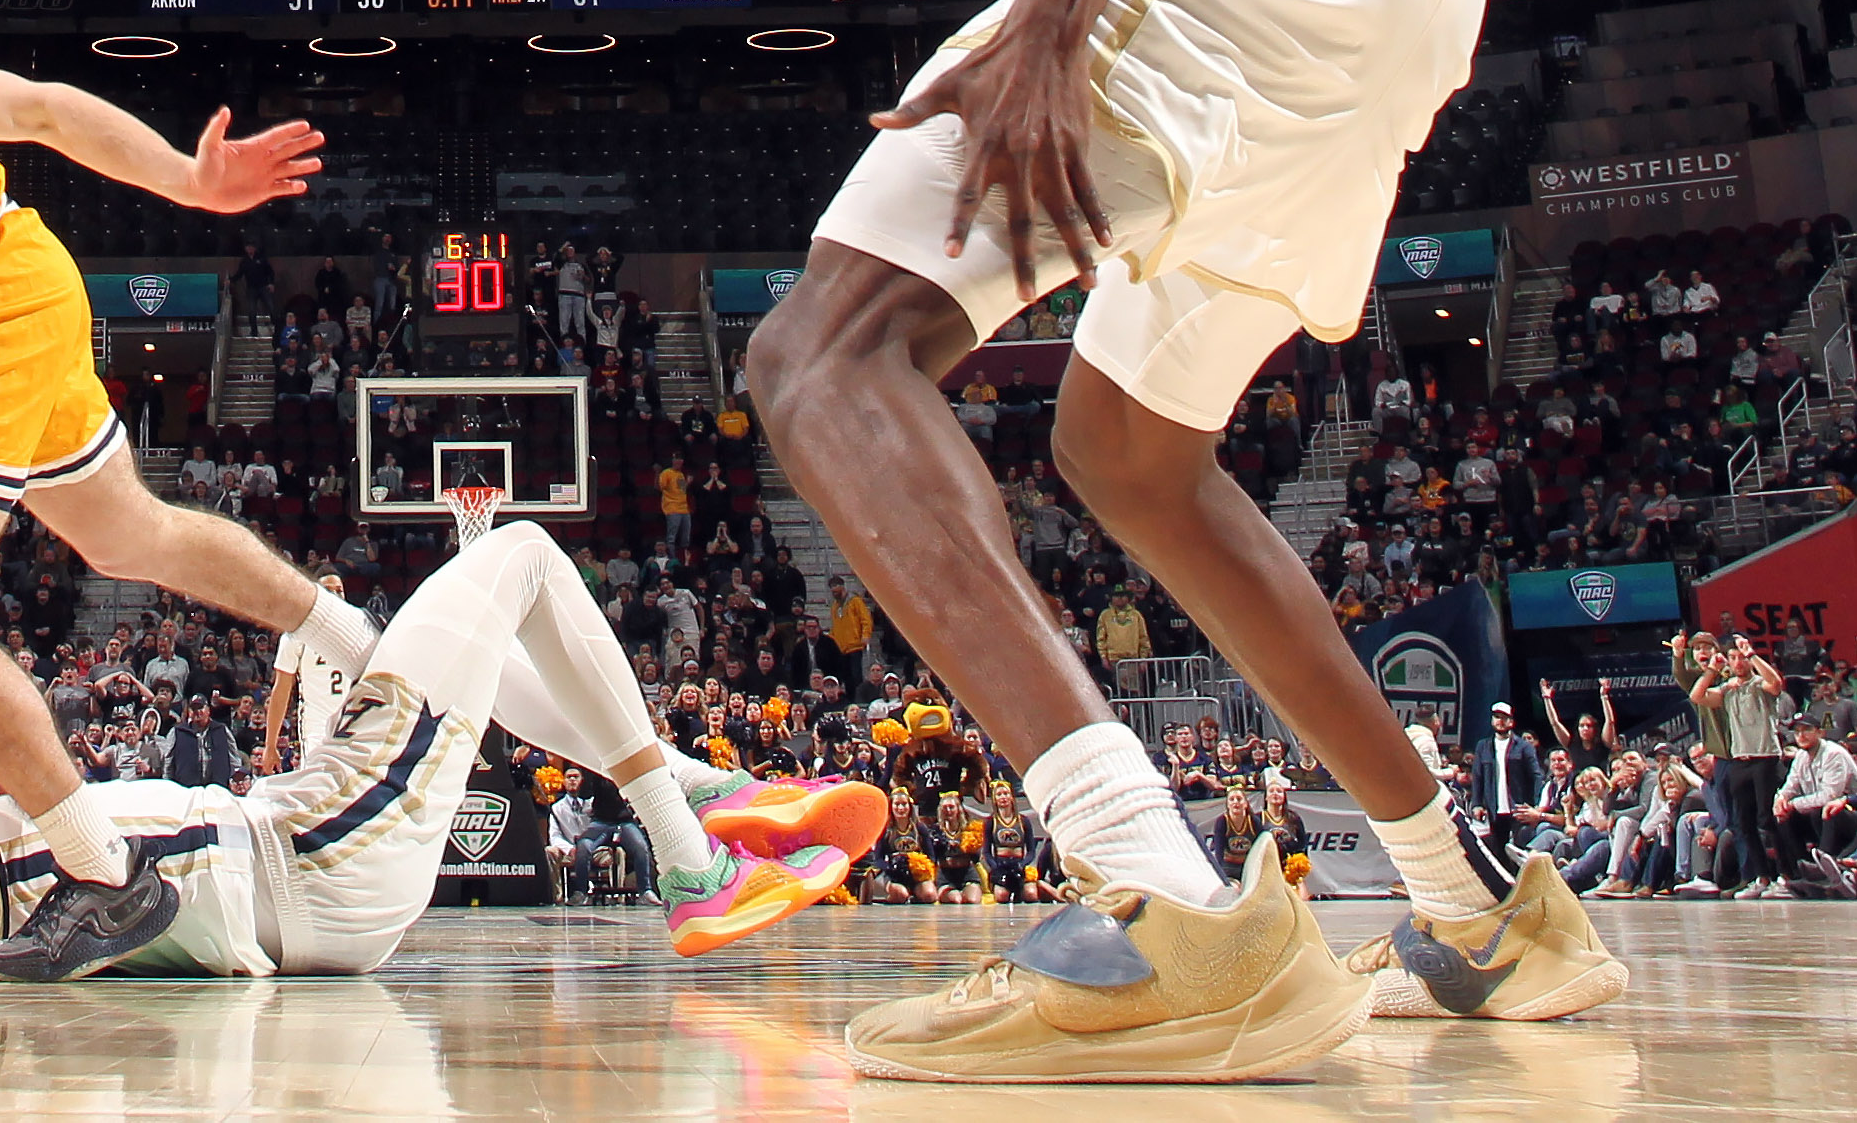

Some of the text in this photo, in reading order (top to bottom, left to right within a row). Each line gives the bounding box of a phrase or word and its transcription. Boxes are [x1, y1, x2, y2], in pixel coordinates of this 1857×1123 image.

[1570, 153, 1732, 185] WESTFIELD
[1546, 185, 1737, 216] CHAMPIONS CLUB
[445, 232, 509, 260] 6:11
[1406, 249, 1439, 262] MAC
[134, 287, 165, 299] MAC
[434, 261, 505, 312] 30
[1577, 584, 1615, 600] MAC
[1744, 601, 1828, 637] SEAT
[924, 770, 942, 788] 24
[1305, 831, 1360, 852] HES
[439, 862, 536, 876] omeMACtion.com
